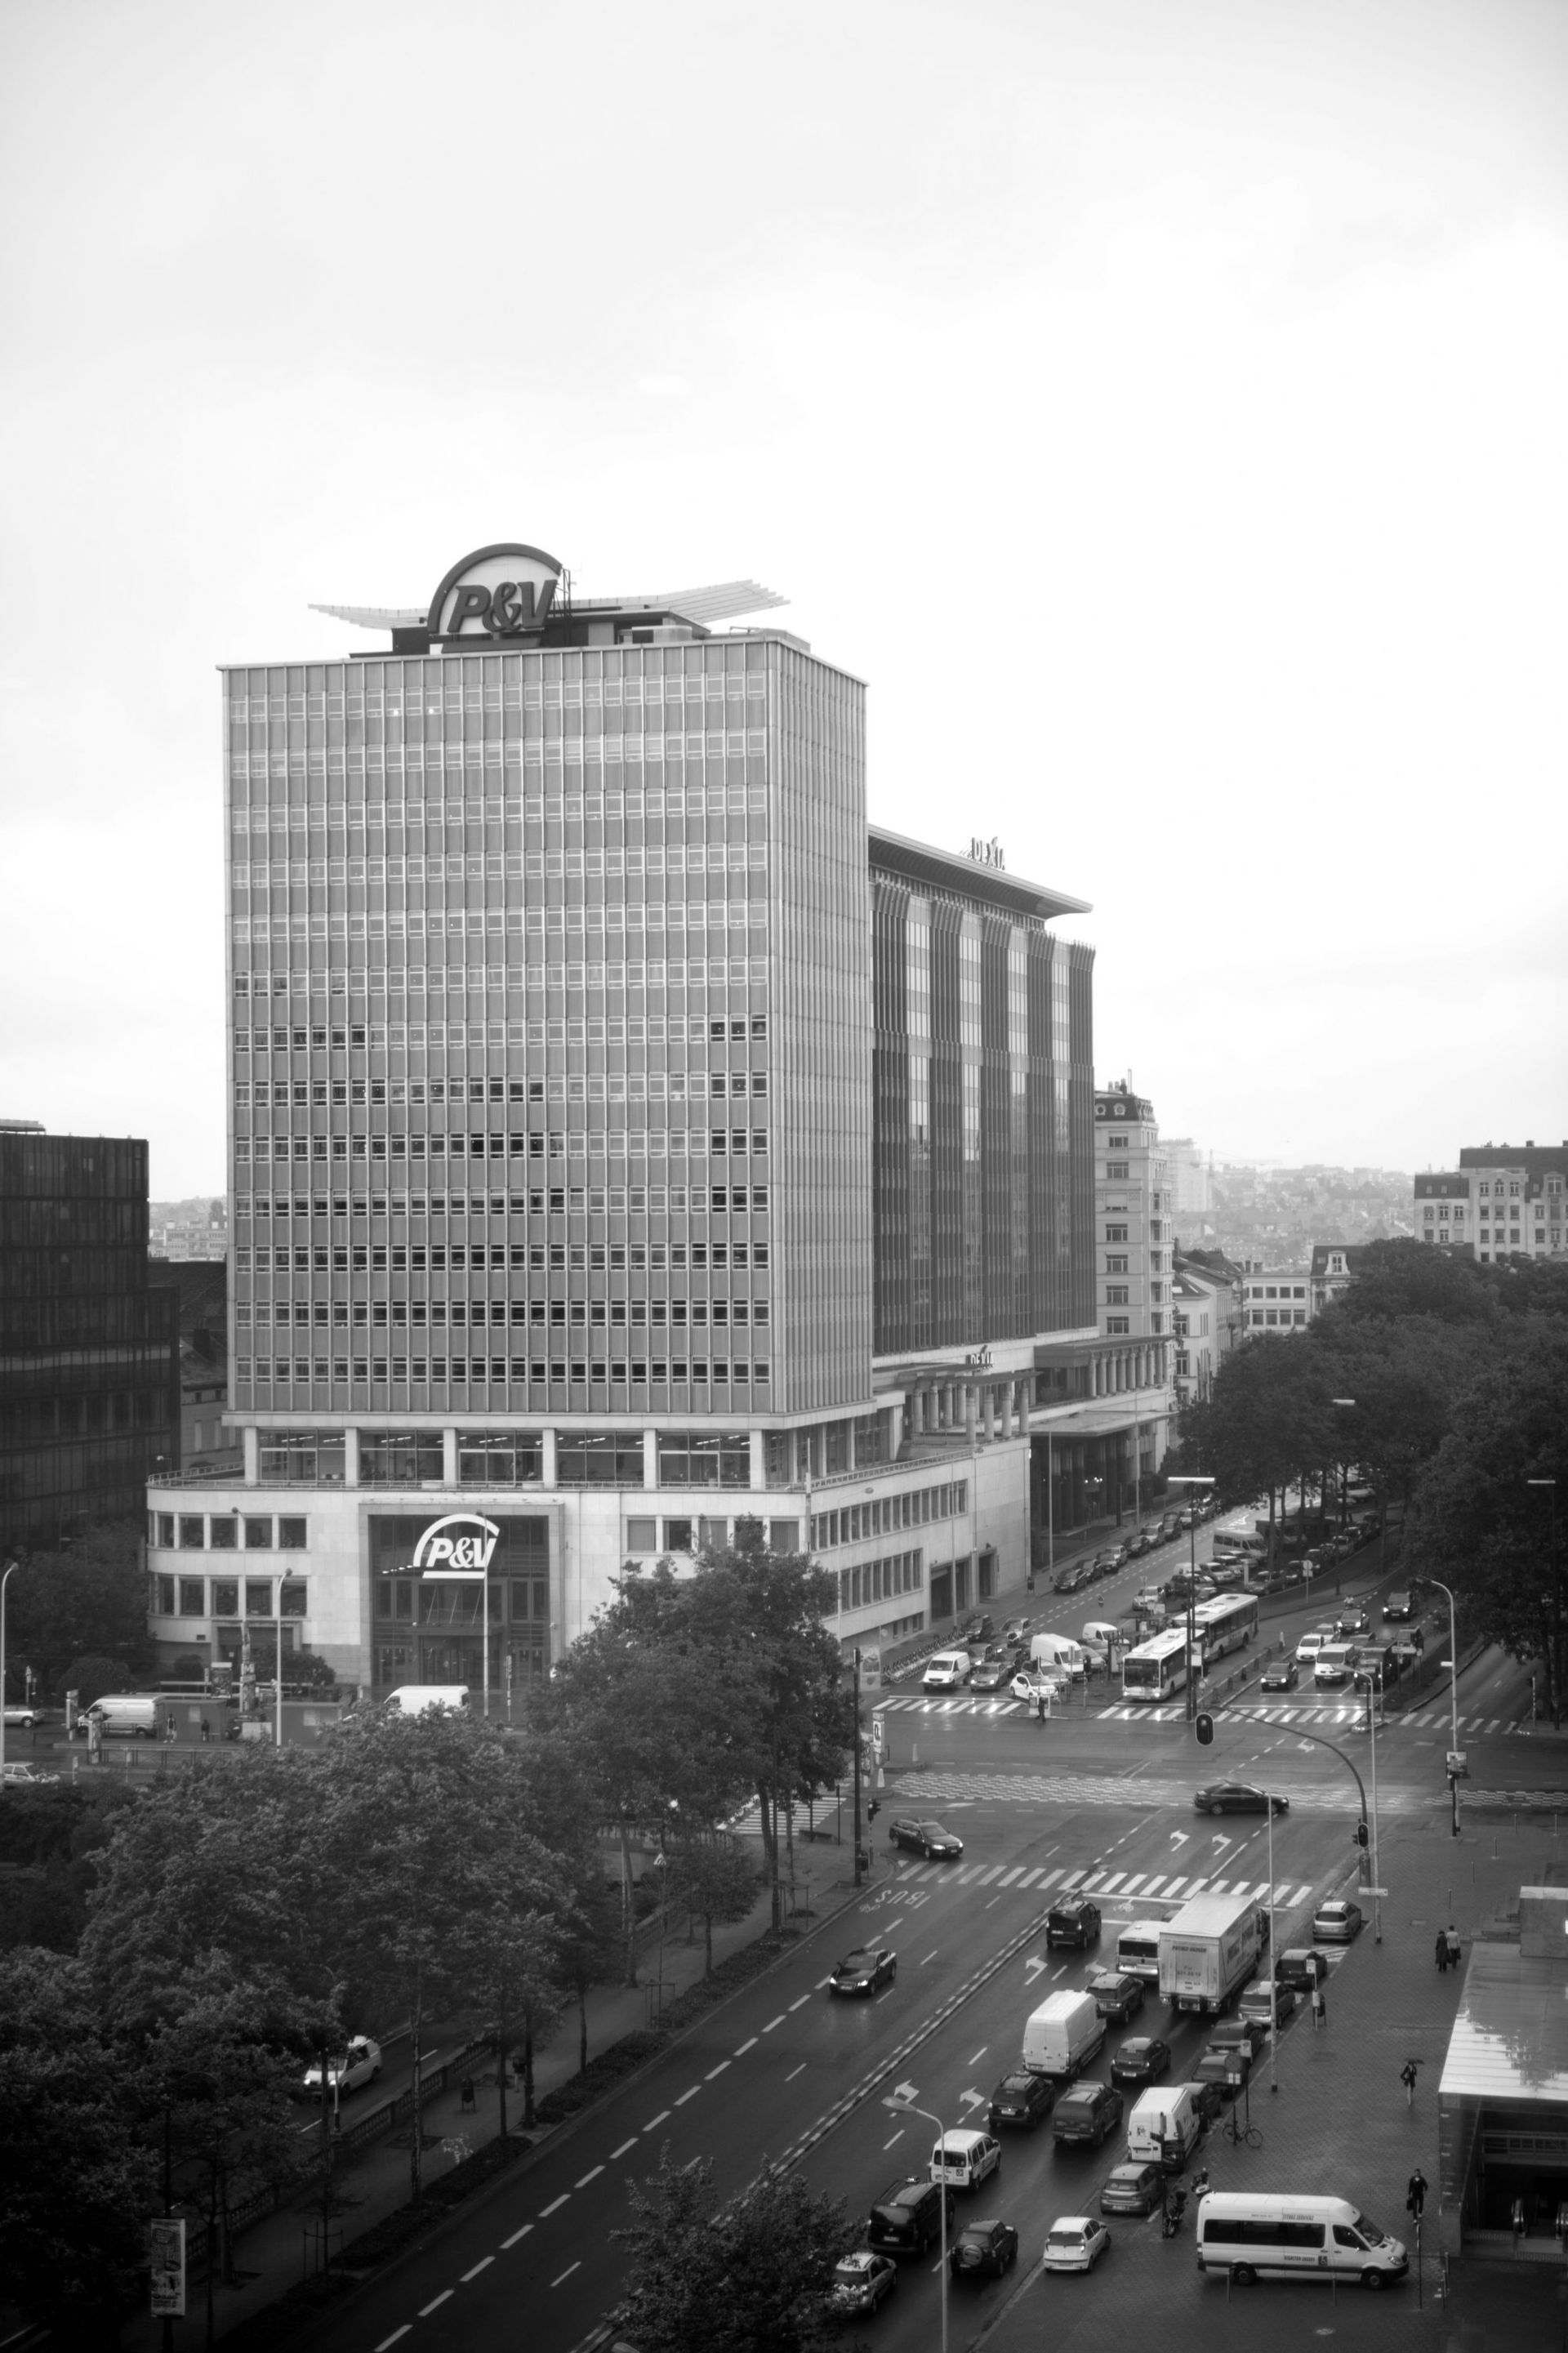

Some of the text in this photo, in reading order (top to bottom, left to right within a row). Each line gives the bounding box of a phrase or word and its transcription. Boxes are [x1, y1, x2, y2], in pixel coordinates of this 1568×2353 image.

[447, 580, 558, 633] P&V
[425, 1537, 497, 1568] P&V
[875, 1889, 926, 1905] BUS
